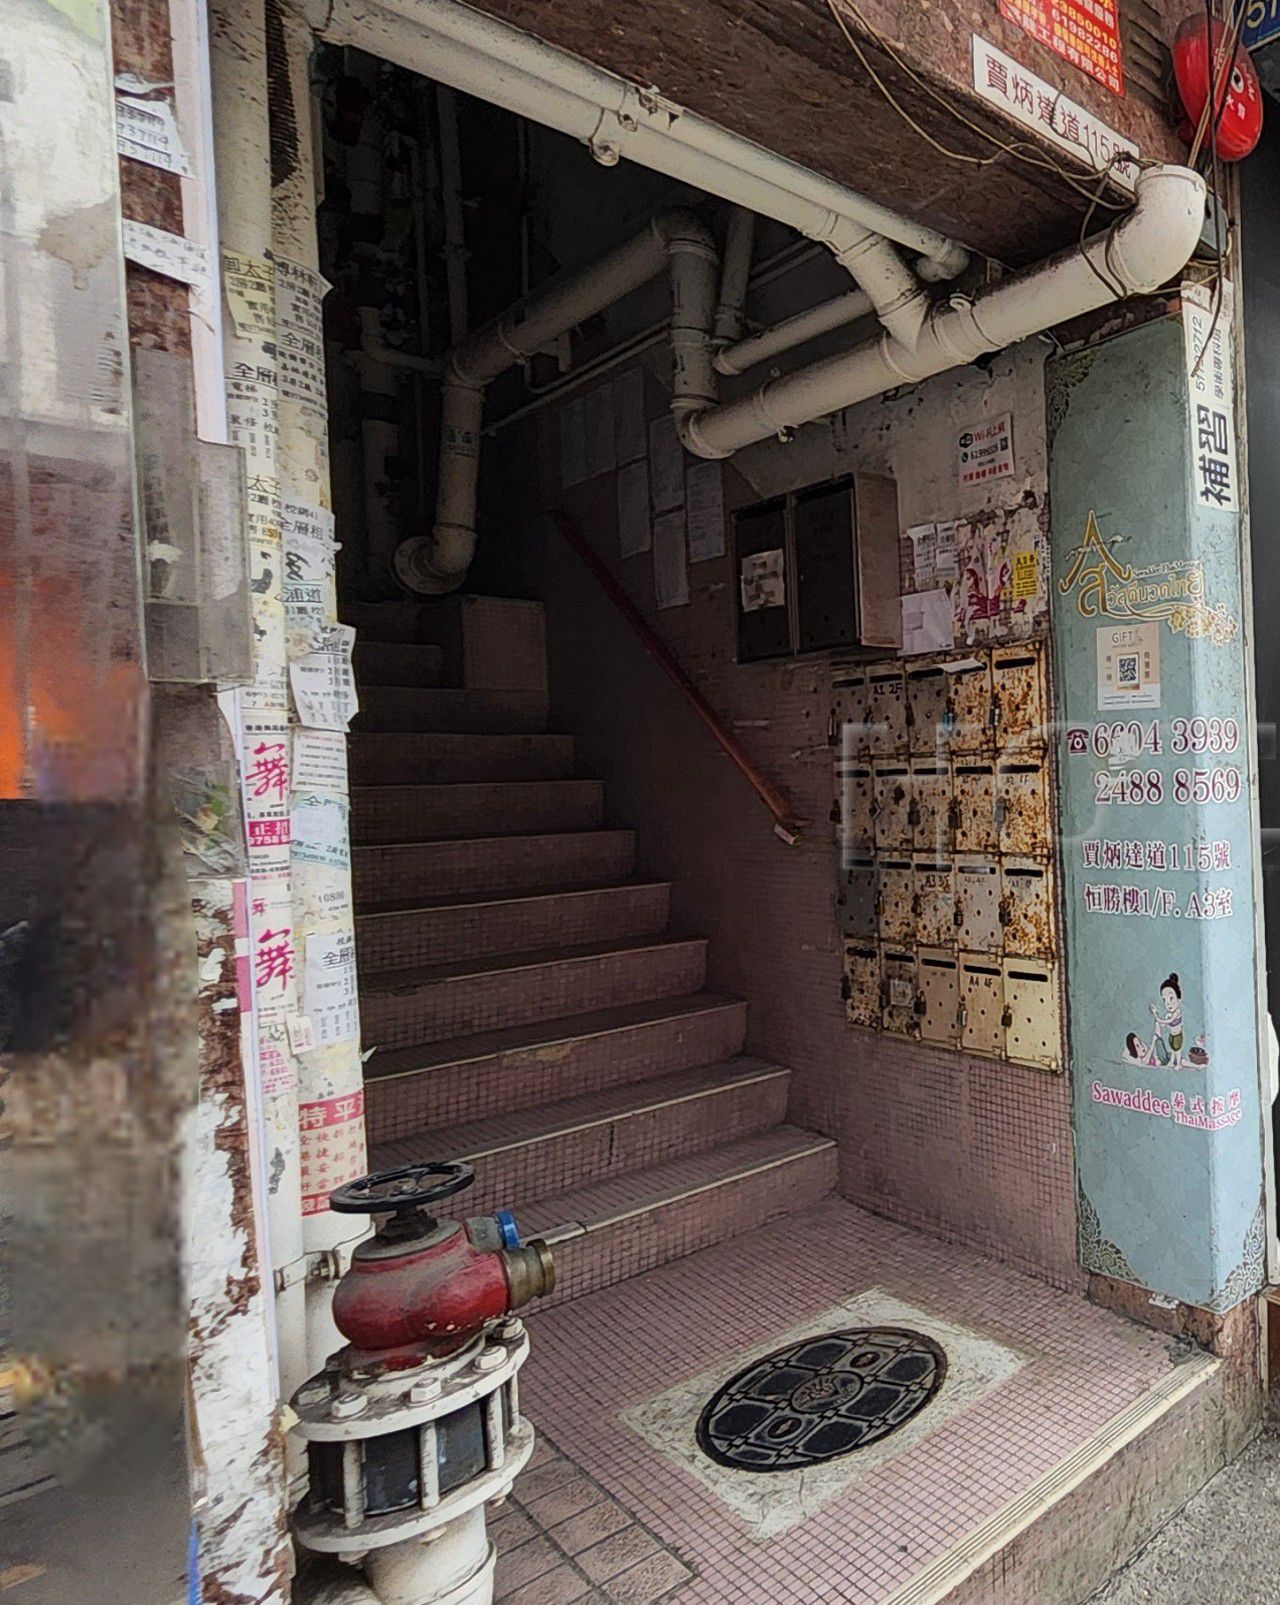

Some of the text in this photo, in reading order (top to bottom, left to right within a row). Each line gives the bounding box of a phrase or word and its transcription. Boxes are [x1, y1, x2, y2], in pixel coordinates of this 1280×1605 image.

[1197, 403, 1232, 506] 補習
[1172, 718, 1239, 754] 3939
[1095, 767, 1241, 804] 2488 8569
[1083, 841, 1231, 871] 賈炳達道115號
[1093, 1081, 1171, 1115] Sawaddee
